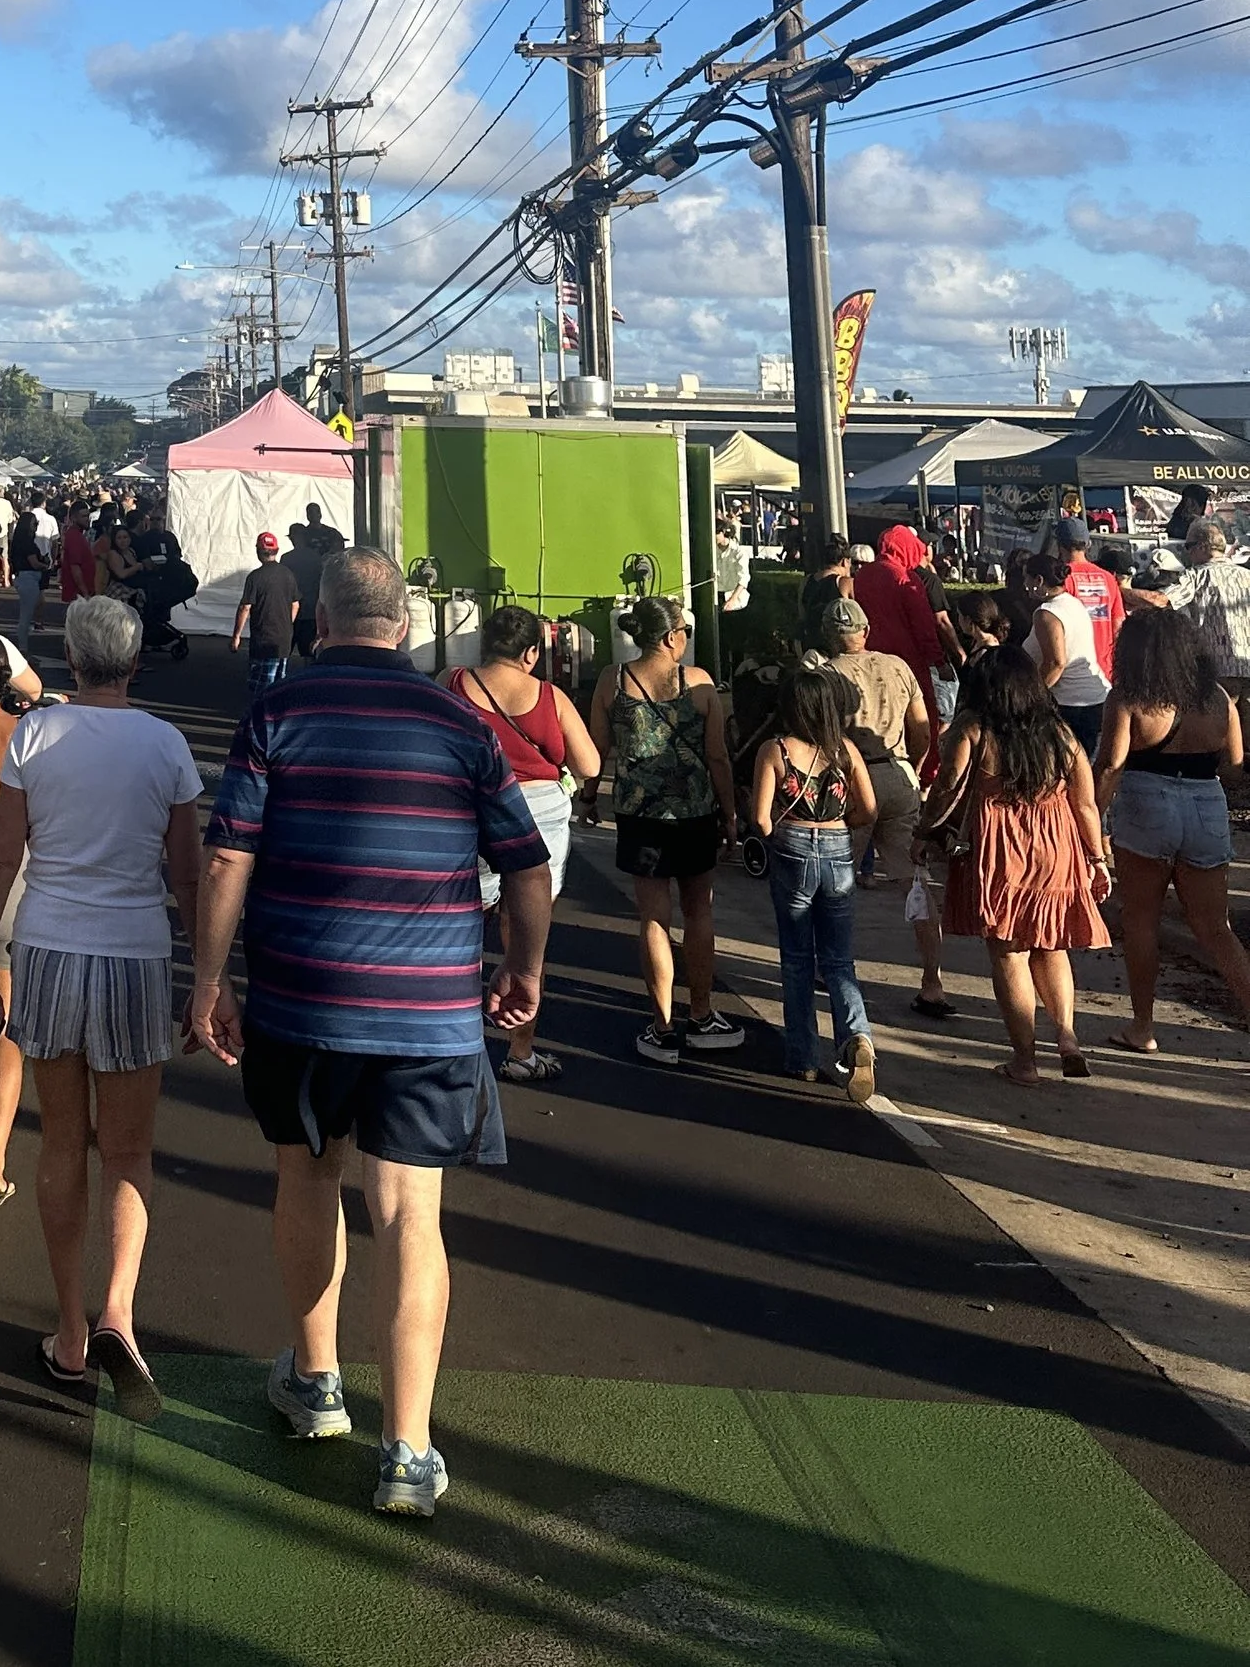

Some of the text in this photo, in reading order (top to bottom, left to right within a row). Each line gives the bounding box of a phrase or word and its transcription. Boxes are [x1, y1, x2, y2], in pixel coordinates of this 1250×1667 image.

[1153, 466, 1174, 480] BE
[1176, 466, 1205, 480] ALL
[1205, 465, 1237, 480] YOU
